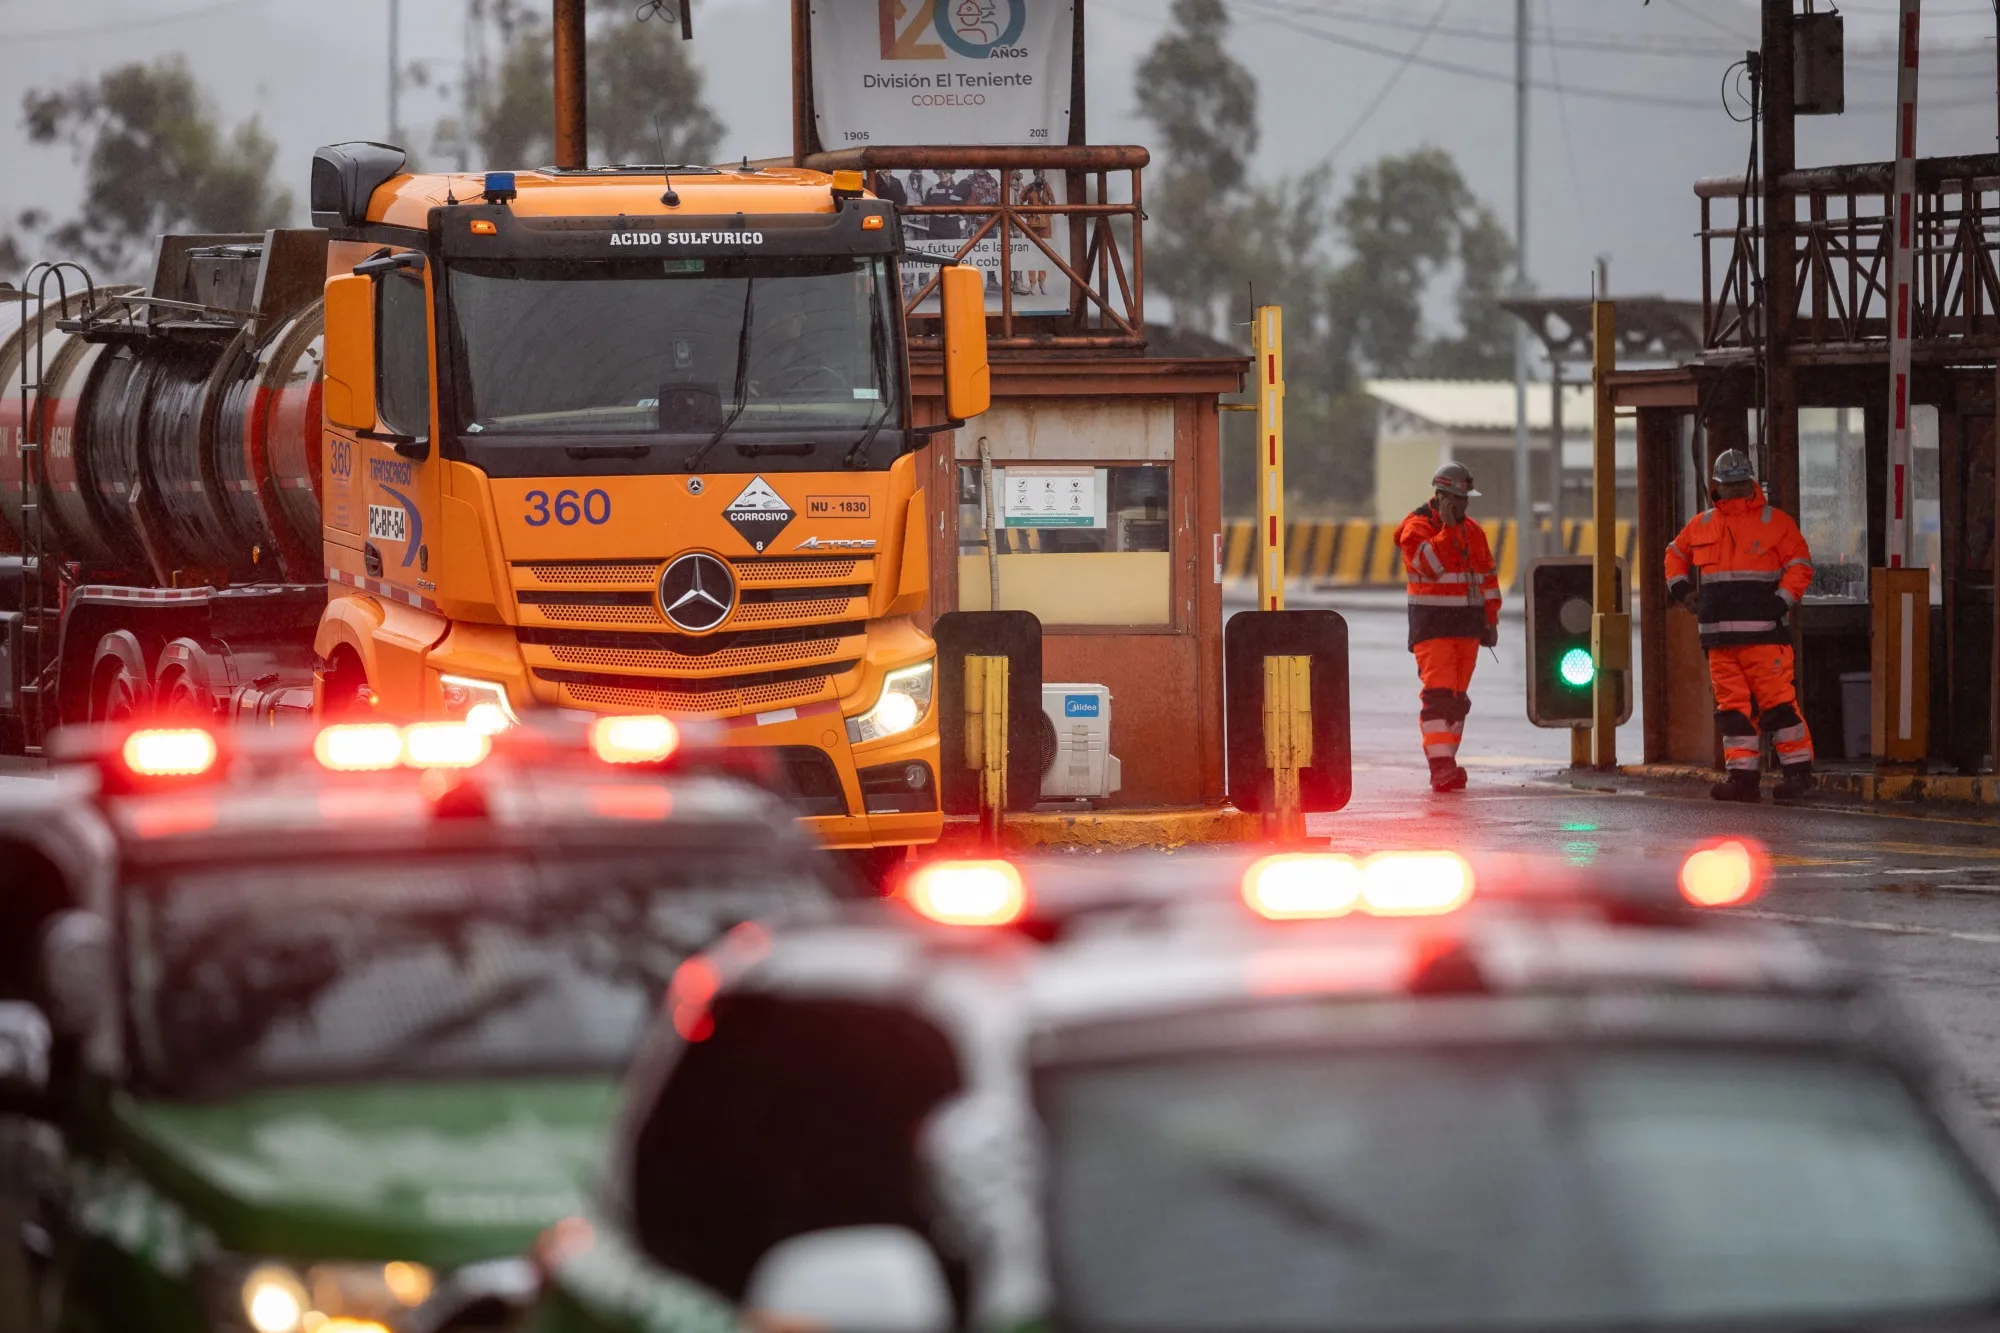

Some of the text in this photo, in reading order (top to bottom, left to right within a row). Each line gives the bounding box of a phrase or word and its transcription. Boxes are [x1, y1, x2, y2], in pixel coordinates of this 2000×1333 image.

[990, 46, 1028, 59] AÑOS
[863, 73, 1033, 88] División El Teniente
[911, 93, 986, 107] CODELCO
[844, 131, 870, 141] 1905
[1029, 128, 1048, 138] 2025
[610, 232, 764, 245] ACIDO SULFURICO
[927, 243, 964, 254] futur
[972, 241, 989, 252] de
[330, 440, 350, 477] 360
[369, 457, 412, 486] TRANSCARGO
[524, 488, 611, 527] 360
[811, 501, 828, 512] NU
[839, 501, 867, 512] 1830
[369, 506, 405, 540] PC-BF-54
[730, 512, 788, 521] CORROSIVO
[756, 541, 763, 551] 8
[1070, 702, 1097, 712] Midea
